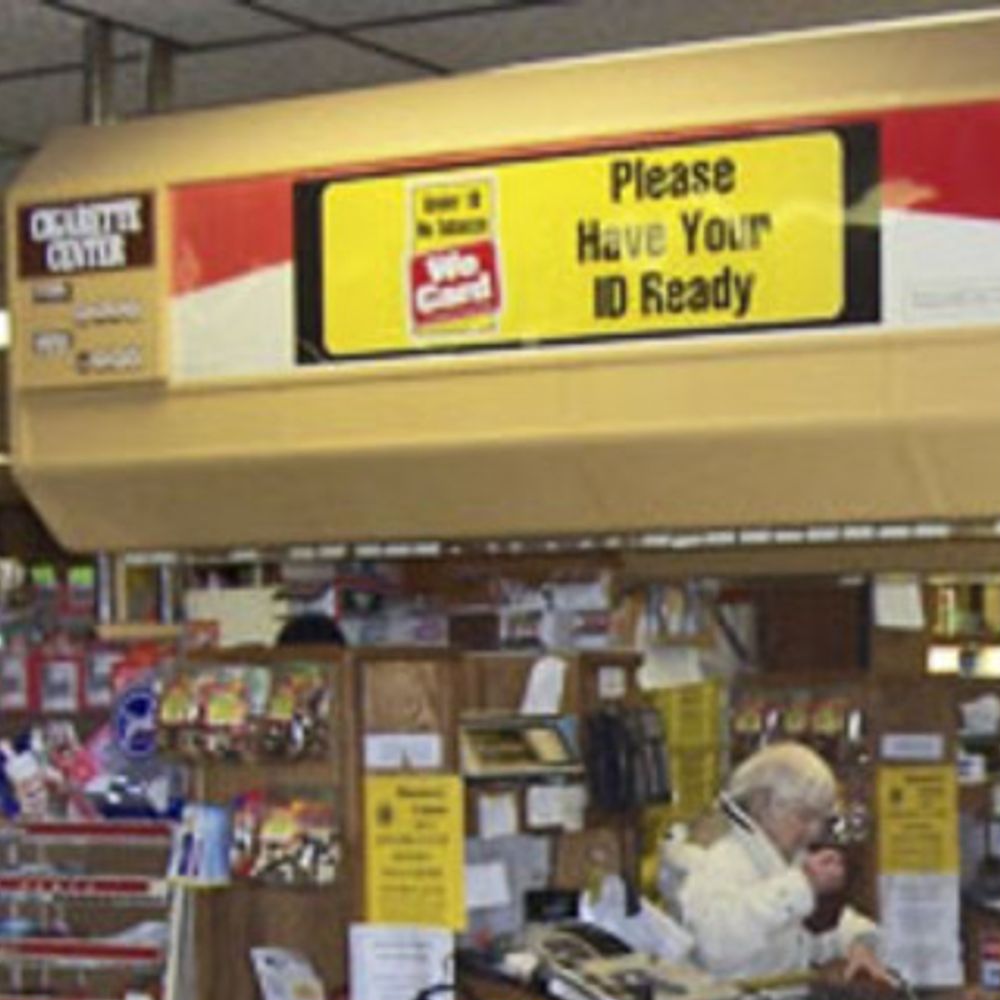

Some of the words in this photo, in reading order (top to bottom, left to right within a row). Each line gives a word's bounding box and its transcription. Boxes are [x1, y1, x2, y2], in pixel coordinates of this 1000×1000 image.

[609, 153, 736, 204] Please
[577, 224, 668, 264] Have
[681, 210, 772, 255] Your
[416, 271, 492, 314] Card
[425, 250, 480, 284] We
[593, 279, 628, 318] ID
[640, 266, 754, 316] Ready
